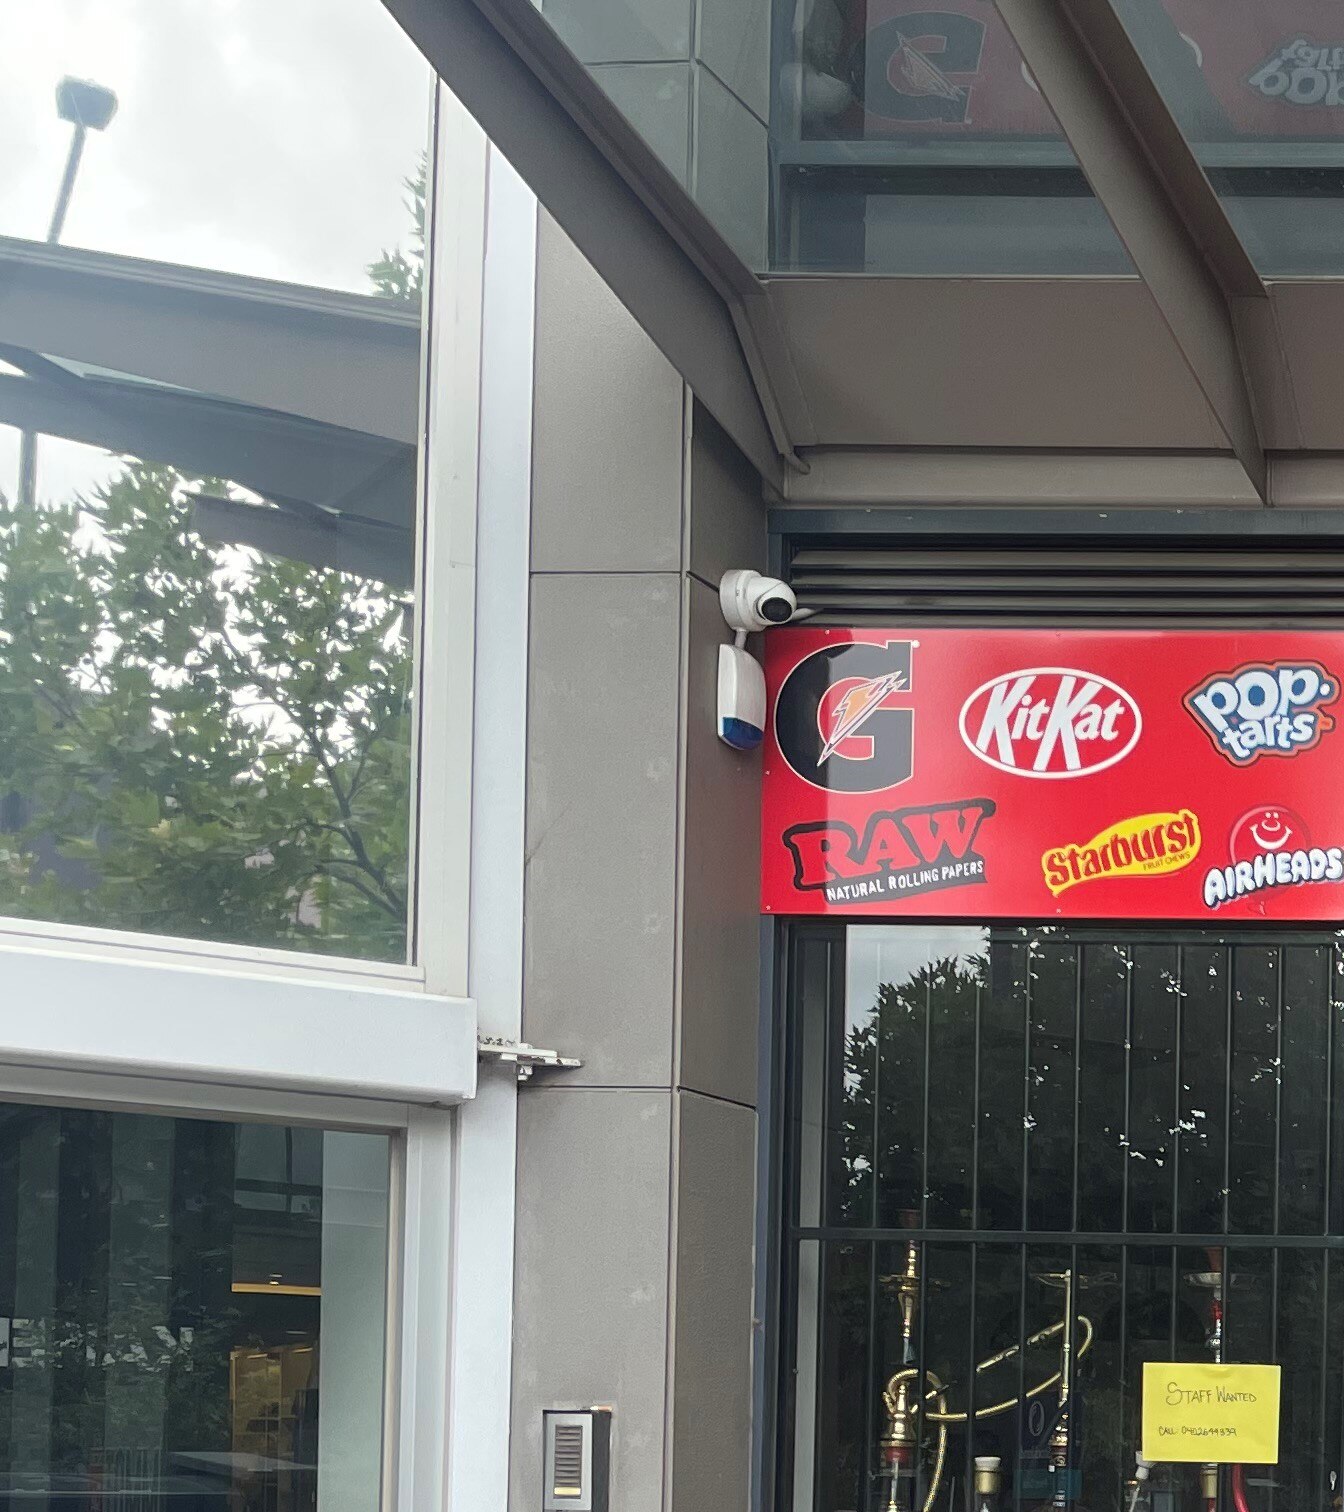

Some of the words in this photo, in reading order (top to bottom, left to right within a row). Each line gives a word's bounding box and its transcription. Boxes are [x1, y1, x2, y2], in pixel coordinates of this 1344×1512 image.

[798, 809, 985, 887] RAW
[1046, 812, 1197, 890] Starburst
[826, 879, 885, 901] NATURAL
[888, 868, 940, 890] ROLLING
[941, 860, 984, 880] PAPERS
[1166, 1382, 1213, 1406] STAFF
[1216, 1386, 1257, 1403] WANTED
